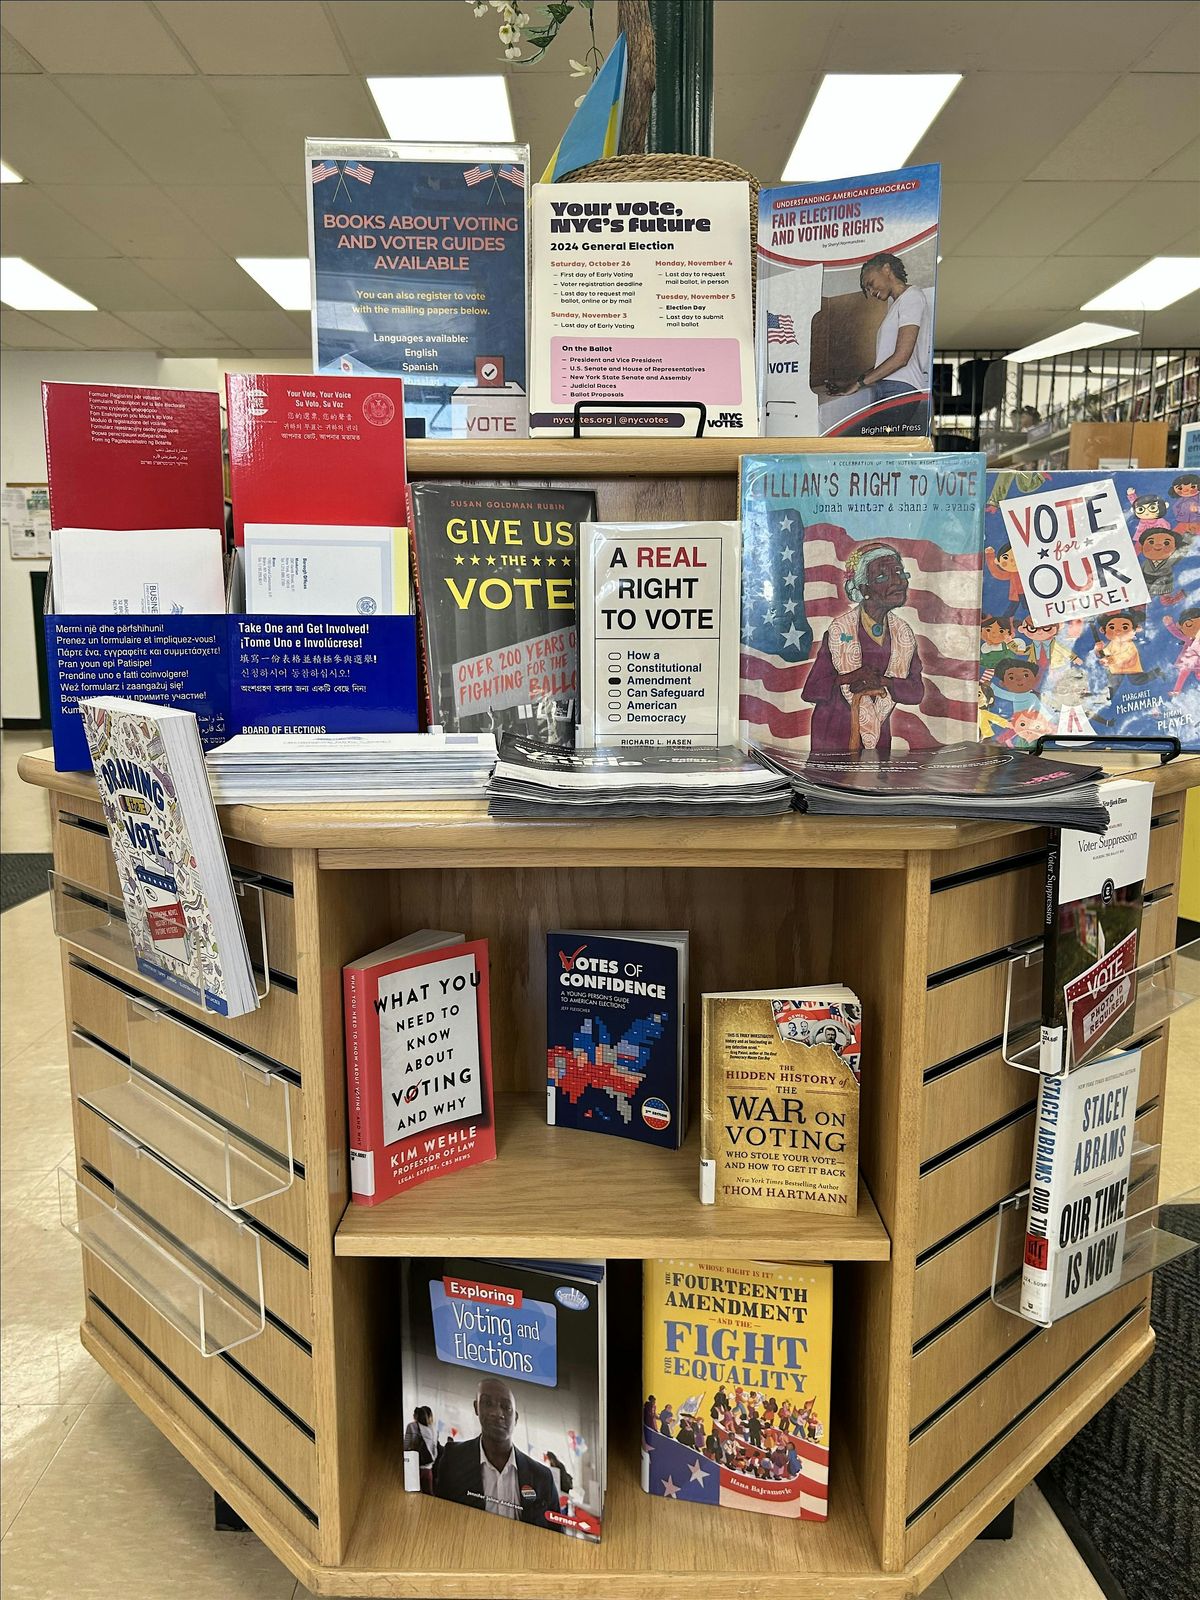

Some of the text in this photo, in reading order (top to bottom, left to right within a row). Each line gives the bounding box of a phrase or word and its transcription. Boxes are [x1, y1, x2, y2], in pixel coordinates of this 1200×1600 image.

[776, 181, 917, 209] UNDERSTANDING AMERICAN DEMOCRACY
[551, 201, 683, 217] Your vote,
[772, 202, 862, 230] FAIR ELECTIONS
[324, 214, 519, 232] BOOKS ABOUT VOTING
[551, 218, 711, 234] NYC's future
[771, 216, 885, 246] AND VOTING RIGHTS
[337, 235, 506, 252] AND VOTER GUIDES
[550, 242, 674, 251] 2024 General Election
[374, 256, 470, 270] AVAILABLE
[551, 260, 587, 268] Saturday,
[655, 260, 686, 268] Monday,
[580, 280, 614, 288] registration
[352, 305, 490, 318] with the mailing papers below.
[373, 333, 468, 345] Languages available:
[405, 348, 438, 360] English
[769, 360, 799, 374] VOTE
[286, 390, 352, 399] Your Vote, Your Voice
[466, 417, 516, 432] VOTE
[707, 420, 744, 428] VOTES
[719, 412, 742, 420] NYC
[850, 472, 901, 498] RIGHT
[908, 474, 928, 496] TO
[936, 471, 978, 498] VOTE
[450, 500, 565, 510] SUSAN GOLDMAN RUBIN
[446, 518, 575, 546] GIVE US
[1008, 492, 1118, 549] VOTE
[500, 554, 527, 566] THE
[609, 546, 708, 568] A REAL
[1053, 536, 1081, 562] for
[1028, 549, 1132, 600] OUR
[444, 578, 576, 610] VOTE
[618, 578, 699, 600] RIGHT
[1045, 586, 1131, 618] FUTURE!
[238, 622, 370, 634] Take One and Get Involved!
[601, 608, 714, 630] TO VOTE
[56, 635, 216, 646] Prenez un formulaire et impliquez-vous!
[240, 637, 363, 650] ¡Tome Uno e Involúcrese!
[458, 652, 569, 706] FIGHTING FOR THE
[627, 663, 702, 673] Constitutional
[627, 676, 692, 685] Amendment
[627, 701, 677, 710] American
[242, 726, 326, 734] BOARD OF ELECTIONS
[627, 713, 687, 724] Democracy
[621, 738, 692, 746] RICHARD L. HASEN
[101, 757, 166, 812] DRAWING
[123, 815, 166, 858] VOTE
[1078, 830, 1138, 853] Voter Suppression
[624, 963, 644, 978] OF
[1086, 953, 1126, 1000] VOTE
[374, 970, 482, 1016] WHAT YOU
[560, 972, 666, 1000] CONFIDENCE
[1090, 984, 1125, 1022] PHOTO ID
[396, 1004, 460, 1033] NEED TO
[1089, 994, 1125, 1036] REQUIRED
[406, 1028, 451, 1052] KNOW
[404, 1048, 454, 1074] ABOUT
[391, 1067, 472, 1108] VOTING
[726, 1070, 849, 1088] HIDDEN HISTORY of
[397, 1096, 467, 1132] AND WHY
[727, 1096, 846, 1128] WAR ON
[1082, 1085, 1129, 1132] STACEY
[390, 1126, 478, 1169] KIM WEHLE
[726, 1125, 847, 1153] VOTING
[1074, 1124, 1126, 1177] ABRAMS
[726, 1150, 749, 1159] WHO
[750, 1152, 780, 1161] STOLE
[782, 1153, 810, 1164] YOUR
[722, 1186, 848, 1204] THOM HARTMANN
[1058, 1176, 1128, 1250] OUR TIME
[1064, 1230, 1119, 1299] IS NOW
[450, 1281, 516, 1307] Exploring
[672, 1272, 808, 1303] FOURTEENTH
[664, 1290, 808, 1324] AMENDMENT
[452, 1302, 541, 1346] Voting and
[454, 1333, 533, 1374] Elections
[664, 1320, 808, 1370] FIGHT
[664, 1356, 808, 1394] FOR EQUALITY
[549, 1512, 578, 1527] Lerner
